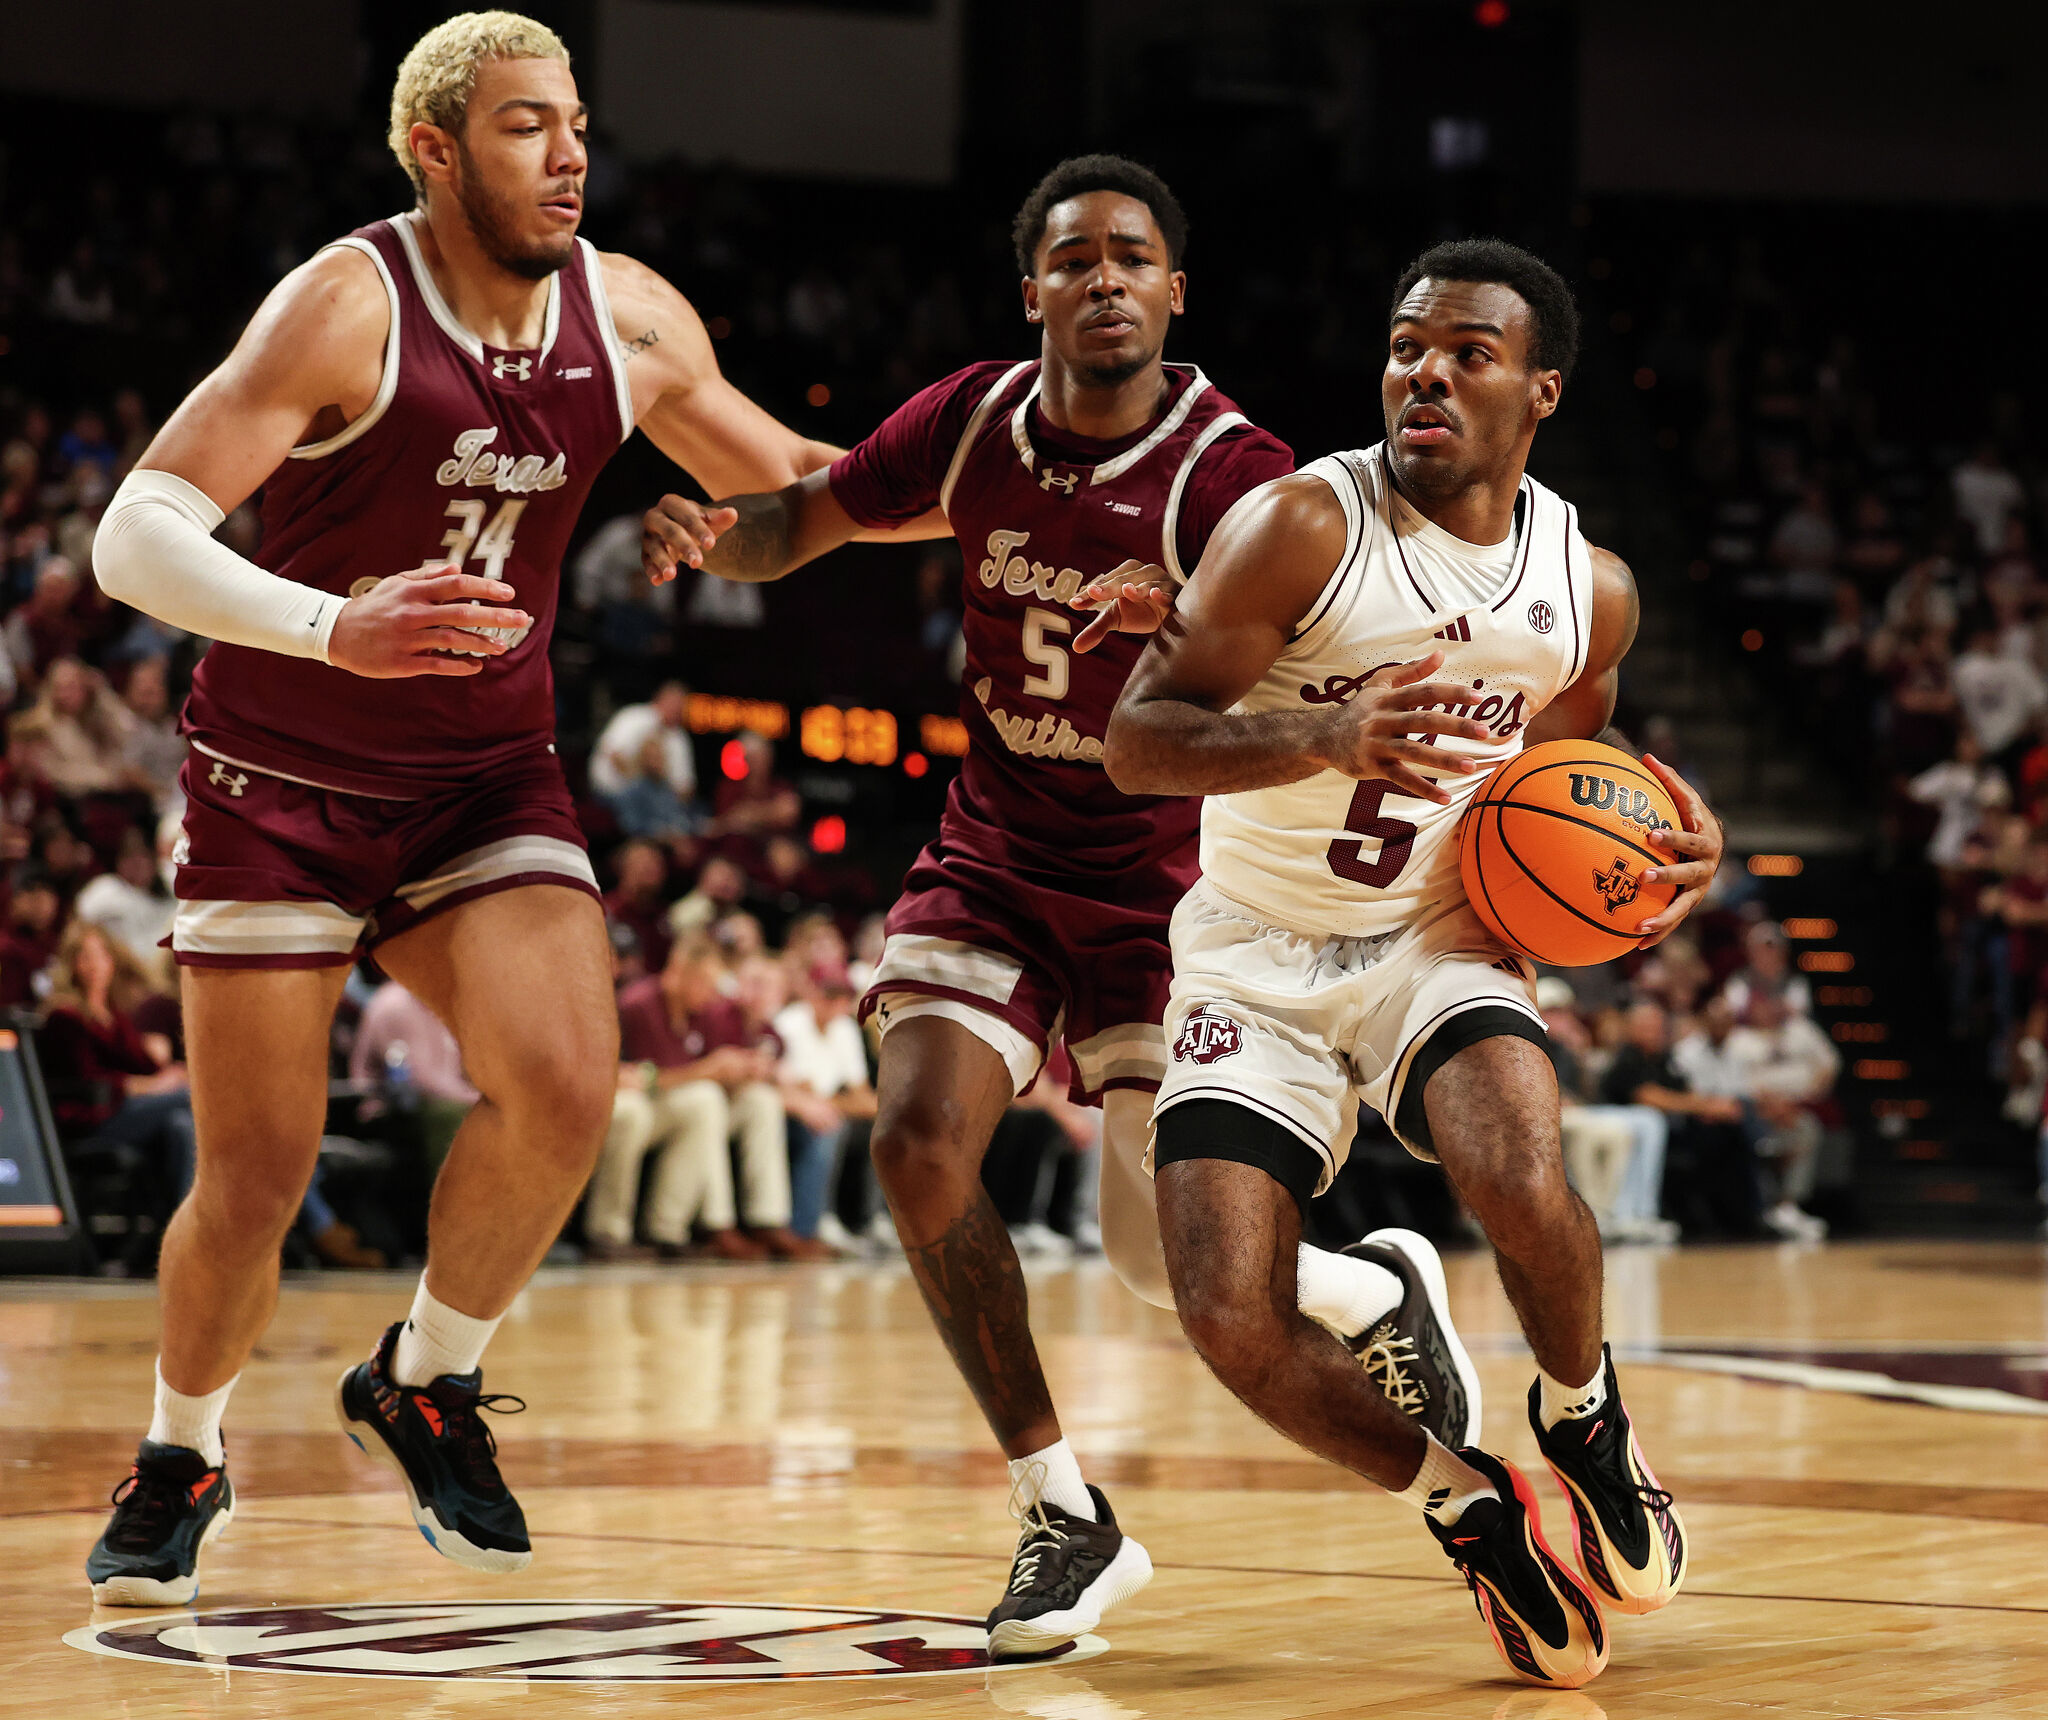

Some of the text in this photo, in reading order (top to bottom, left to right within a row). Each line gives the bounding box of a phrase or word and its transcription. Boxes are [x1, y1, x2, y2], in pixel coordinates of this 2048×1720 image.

[565, 366, 592, 380] SWAC
[436, 426, 568, 493] Texas
[1112, 503, 1142, 516] SWAC
[423, 499, 528, 580] 34
[1531, 603, 1551, 630] SEC
[1022, 606, 1071, 700] 5
[1327, 776, 1438, 889] 5
[1622, 820, 1641, 834] EVO
